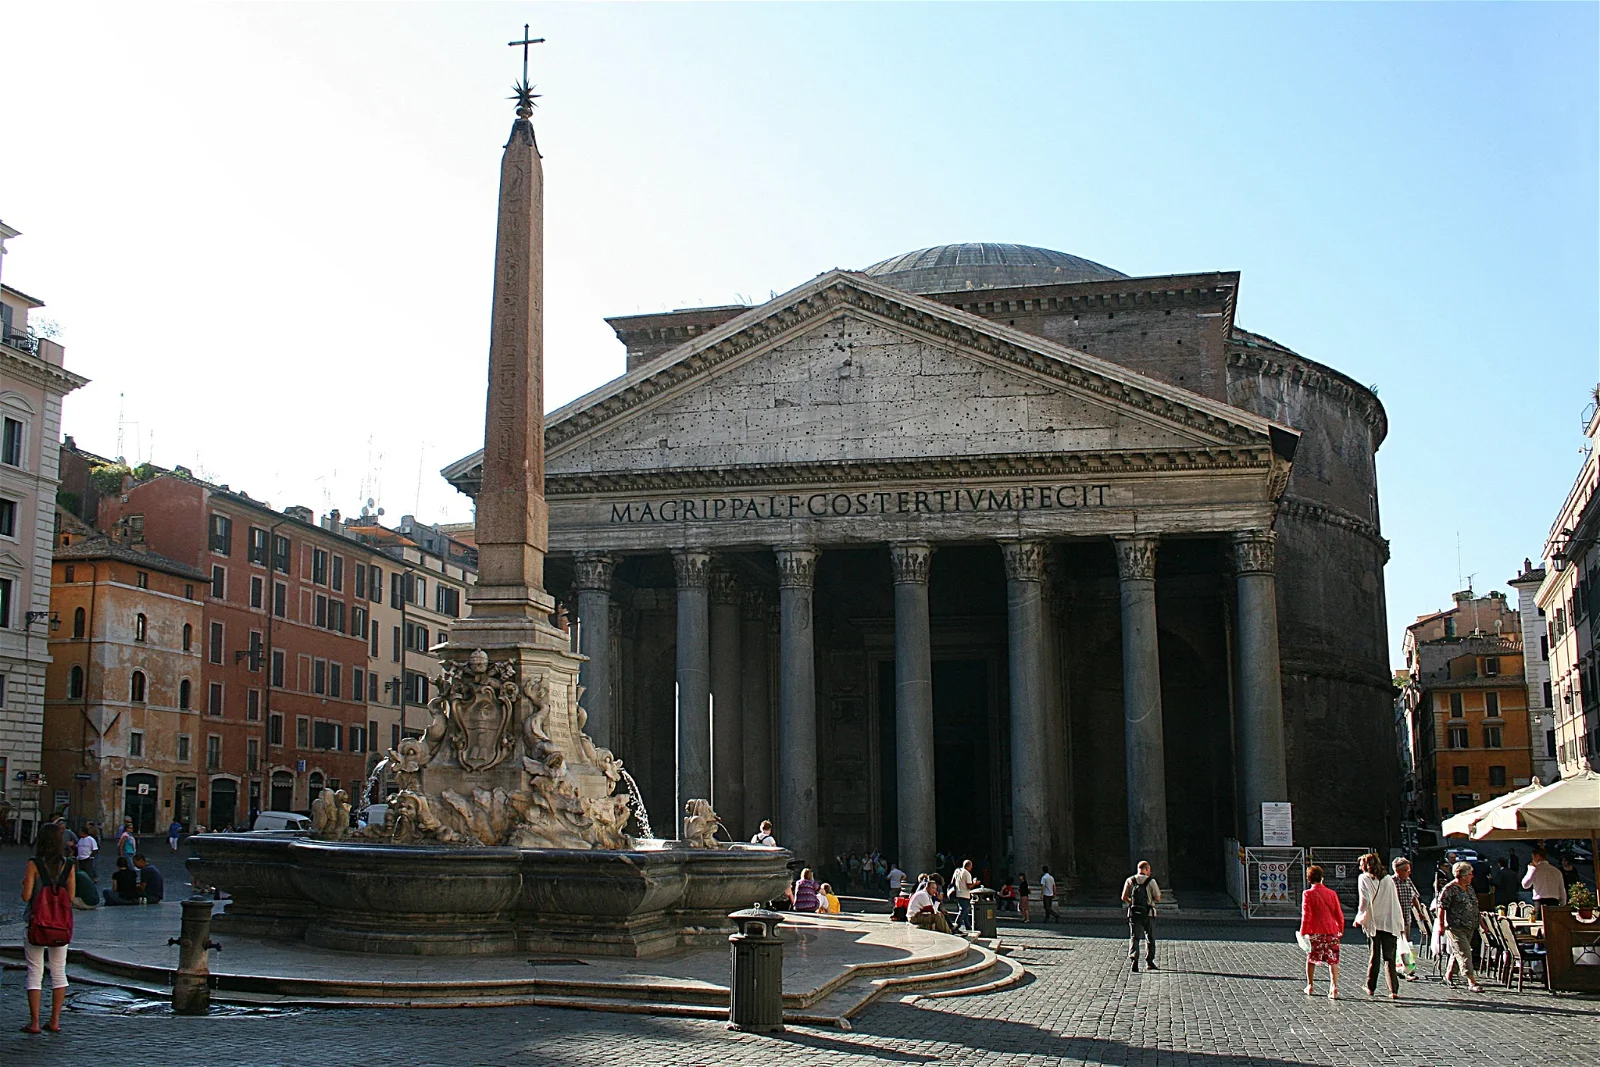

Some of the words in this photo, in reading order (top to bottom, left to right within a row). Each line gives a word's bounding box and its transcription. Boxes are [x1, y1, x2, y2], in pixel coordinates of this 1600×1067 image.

[610, 502, 634, 523] M
[637, 497, 762, 522] AGRIPPA
[768, 496, 782, 518] L
[787, 495, 800, 517] F
[807, 493, 868, 516] COS
[873, 488, 1013, 514] TERTIVM
[1022, 484, 1111, 509] FECIT
